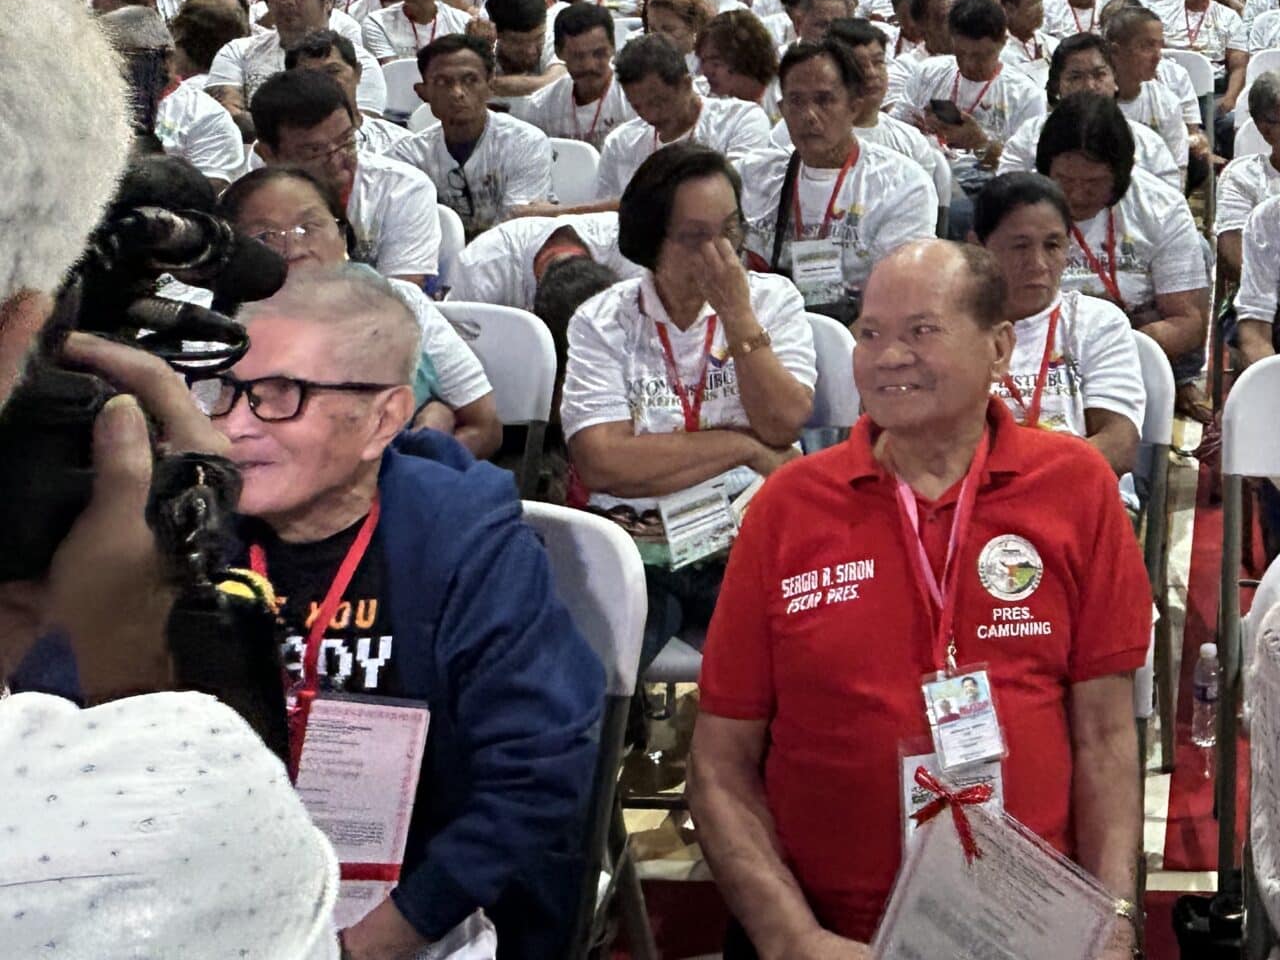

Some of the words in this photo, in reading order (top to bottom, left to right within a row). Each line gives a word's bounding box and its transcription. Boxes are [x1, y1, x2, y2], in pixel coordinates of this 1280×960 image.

[781, 570, 818, 599] SERGIO
[822, 566, 834, 588] R.
[836, 558, 875, 584] SIRON
[826, 583, 860, 606] PRES.
[304, 598, 378, 630] YOU
[992, 606, 1035, 622] PRES.
[976, 621, 1052, 640] CAMUNING
